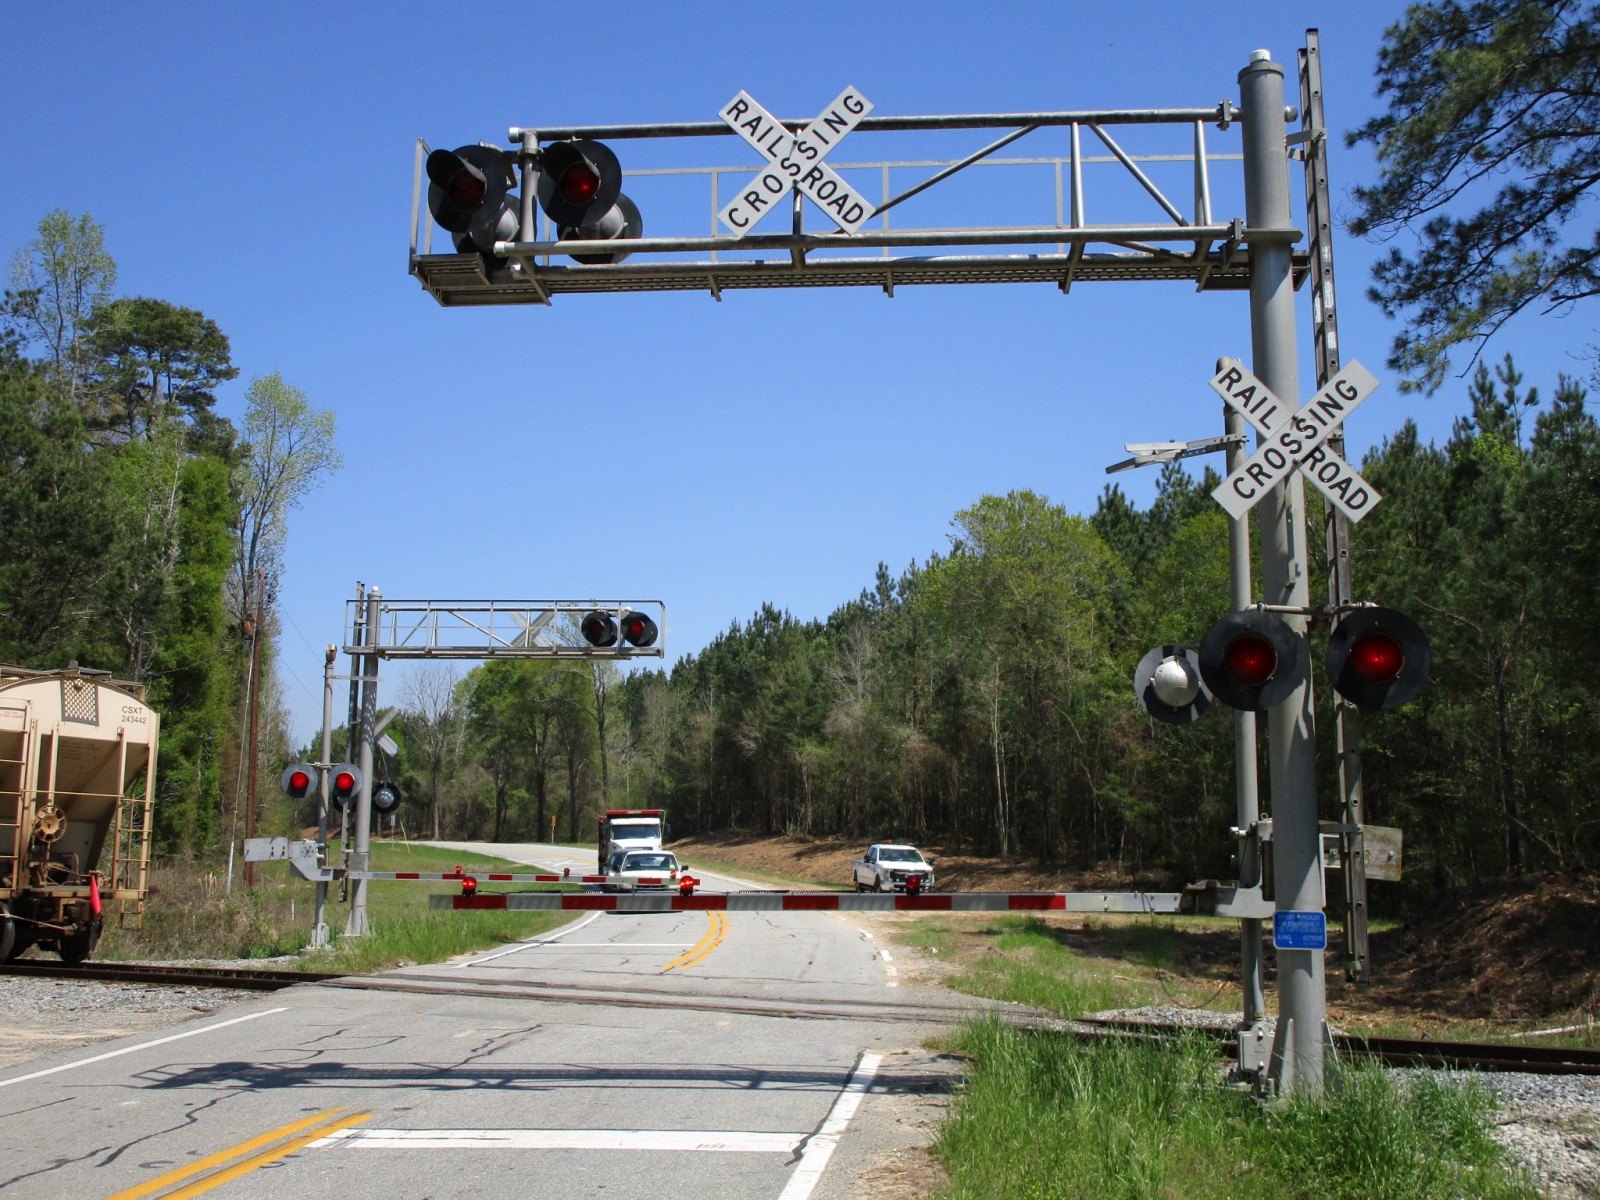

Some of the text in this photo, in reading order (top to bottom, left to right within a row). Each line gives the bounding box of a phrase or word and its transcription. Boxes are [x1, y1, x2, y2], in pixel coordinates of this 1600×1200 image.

[726, 98, 864, 225] RAIL ROAD
[728, 95, 864, 228] CROSSING
[1217, 366, 1369, 511] RAIL ROAD
[1232, 379, 1358, 500] CROSSING
[121, 705, 143, 715] CSXT
